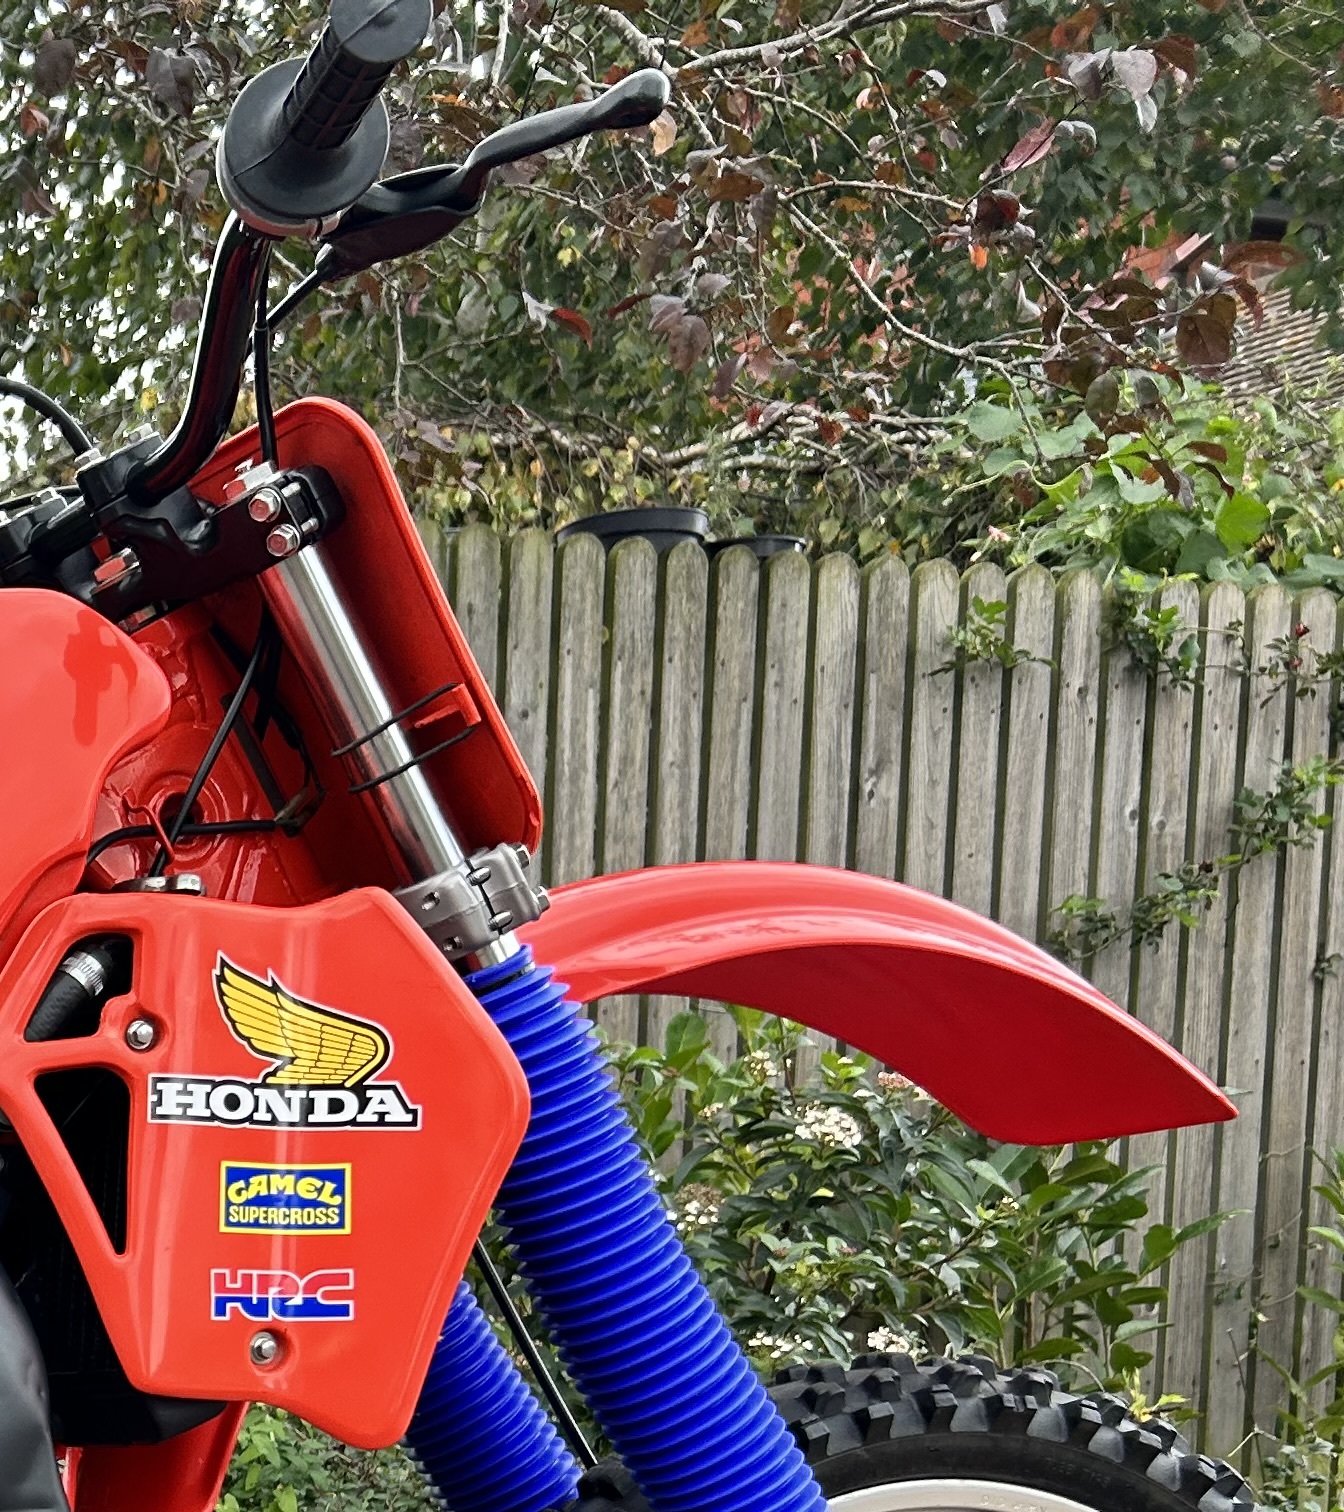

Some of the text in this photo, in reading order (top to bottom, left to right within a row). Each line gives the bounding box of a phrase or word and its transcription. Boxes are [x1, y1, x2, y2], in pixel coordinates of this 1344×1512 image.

[155, 1082, 414, 1124] HONDA
[226, 1173, 343, 1207] CAMEL
[228, 1205, 340, 1226] SUPERCROSS
[210, 1268, 355, 1322] HRC
